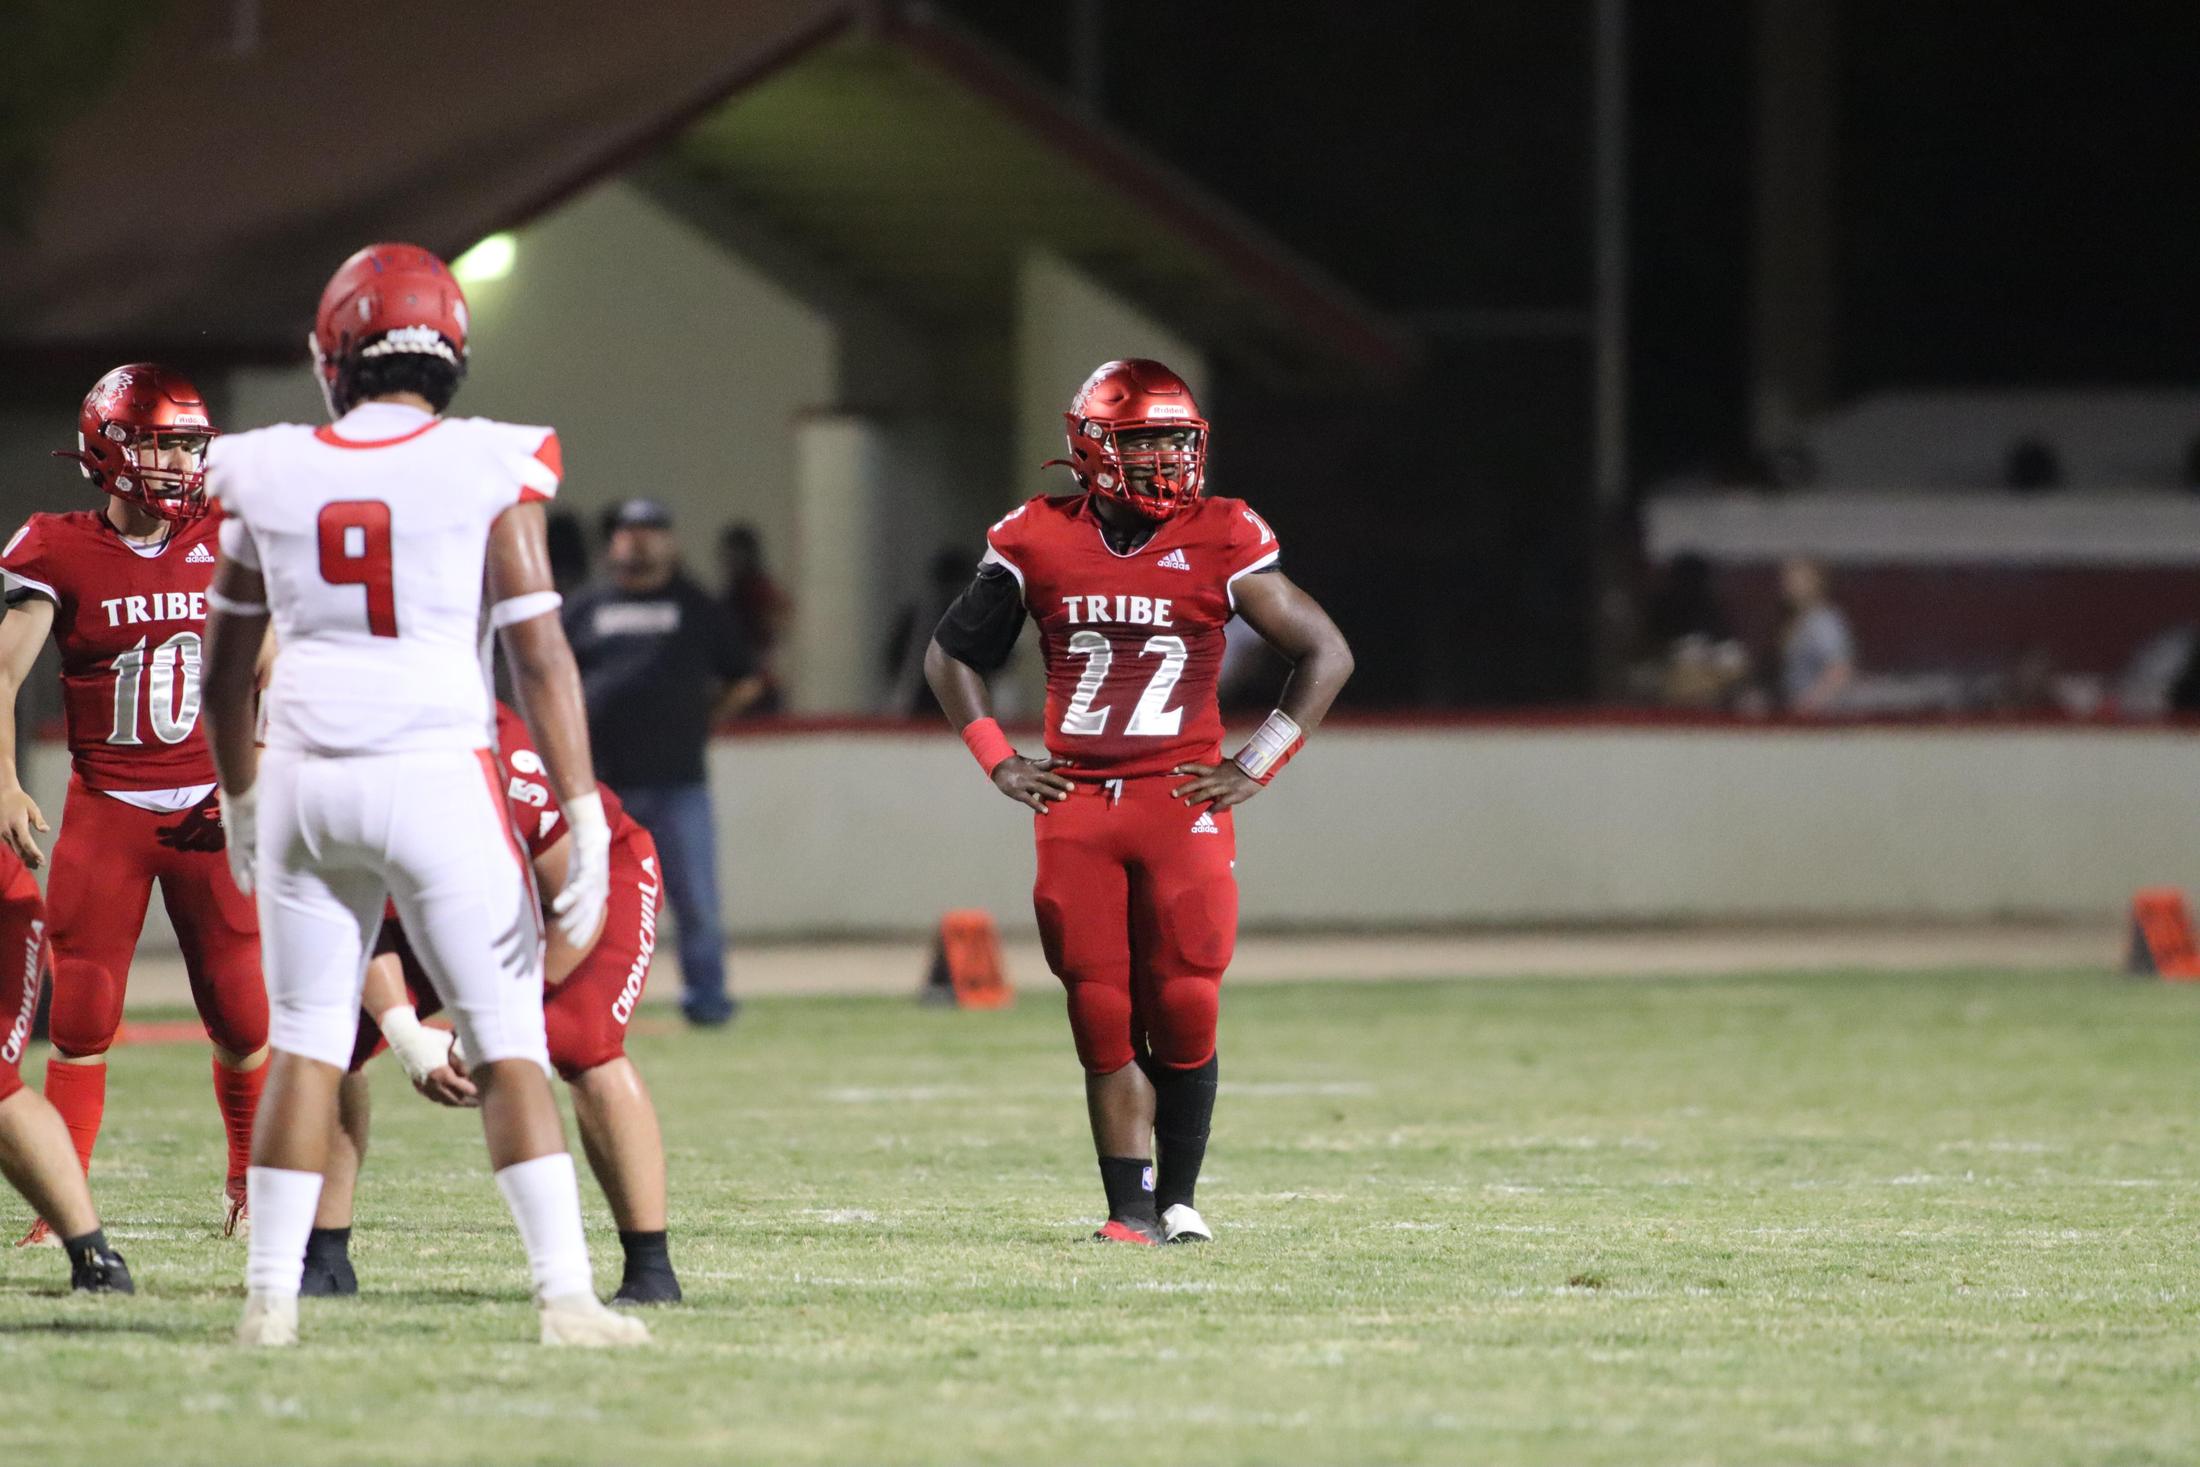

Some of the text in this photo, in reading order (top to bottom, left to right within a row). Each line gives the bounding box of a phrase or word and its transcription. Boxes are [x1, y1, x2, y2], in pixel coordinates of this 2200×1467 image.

[185, 555, 215, 563] adidas
[317, 501, 398, 638] 9
[1157, 559, 1190, 571] adidas
[101, 592, 207, 627] TRIBE
[1062, 595, 1173, 627] TRIBE
[105, 631, 202, 744] 10
[1060, 630, 1188, 735] 22
[508, 749, 549, 807] 59
[1191, 825, 1219, 835] adidas
[611, 856, 659, 1025] CHOWCHILLA
